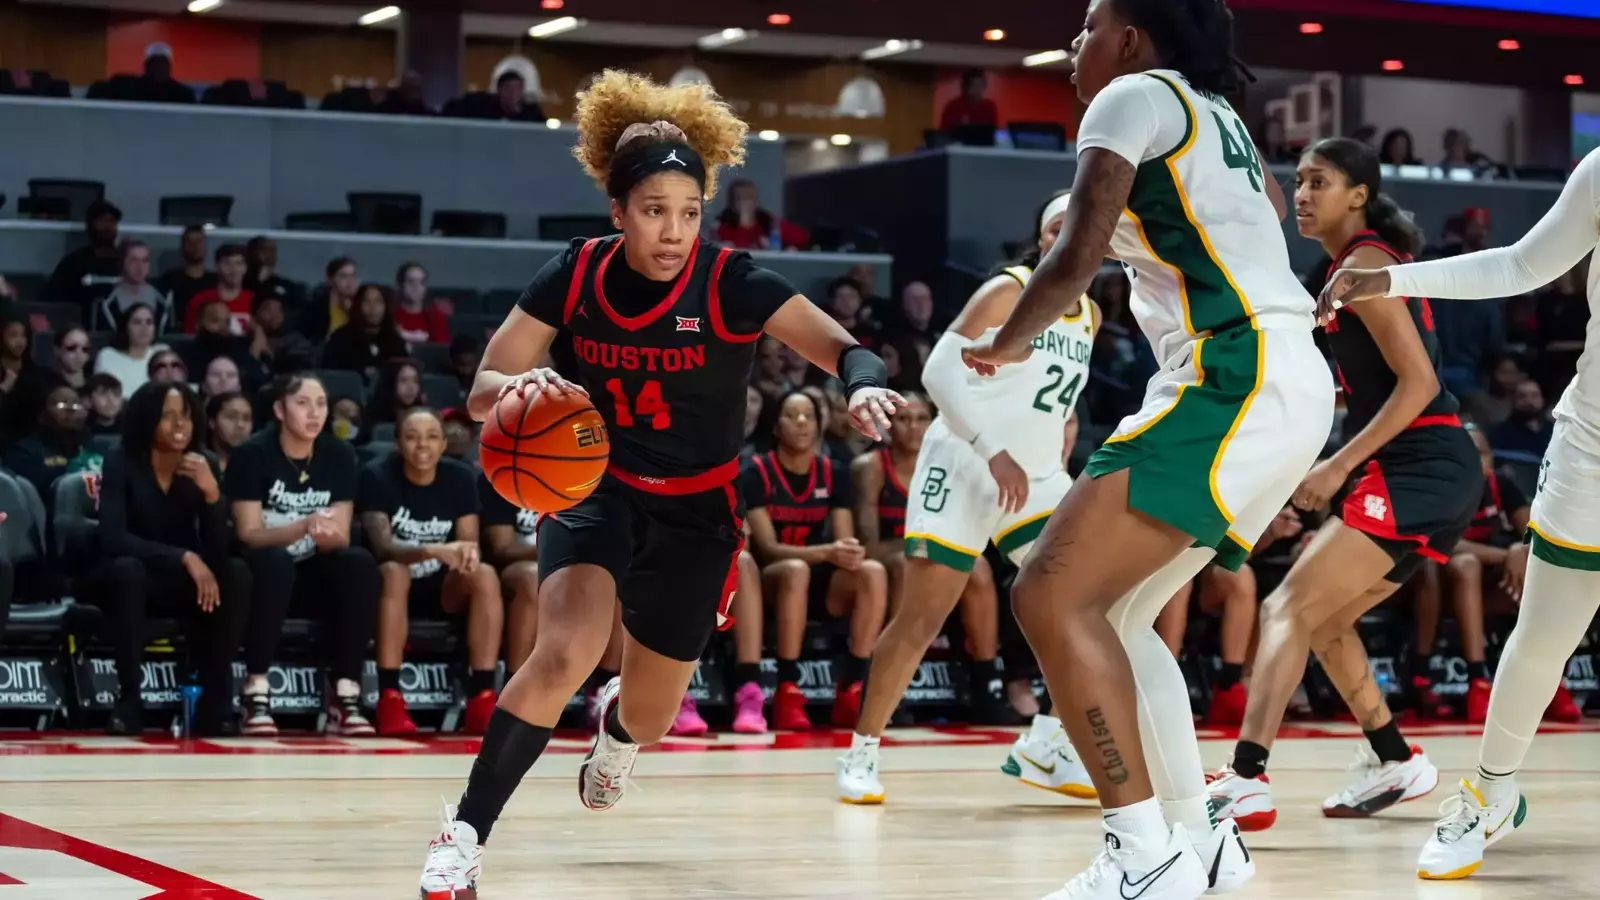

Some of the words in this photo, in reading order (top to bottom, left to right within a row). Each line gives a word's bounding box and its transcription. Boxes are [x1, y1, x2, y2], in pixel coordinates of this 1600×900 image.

[606, 378, 671, 430] 14
[1033, 364, 1081, 418] 24
[268, 479, 331, 507] Houston
[391, 506, 453, 536] Houston
